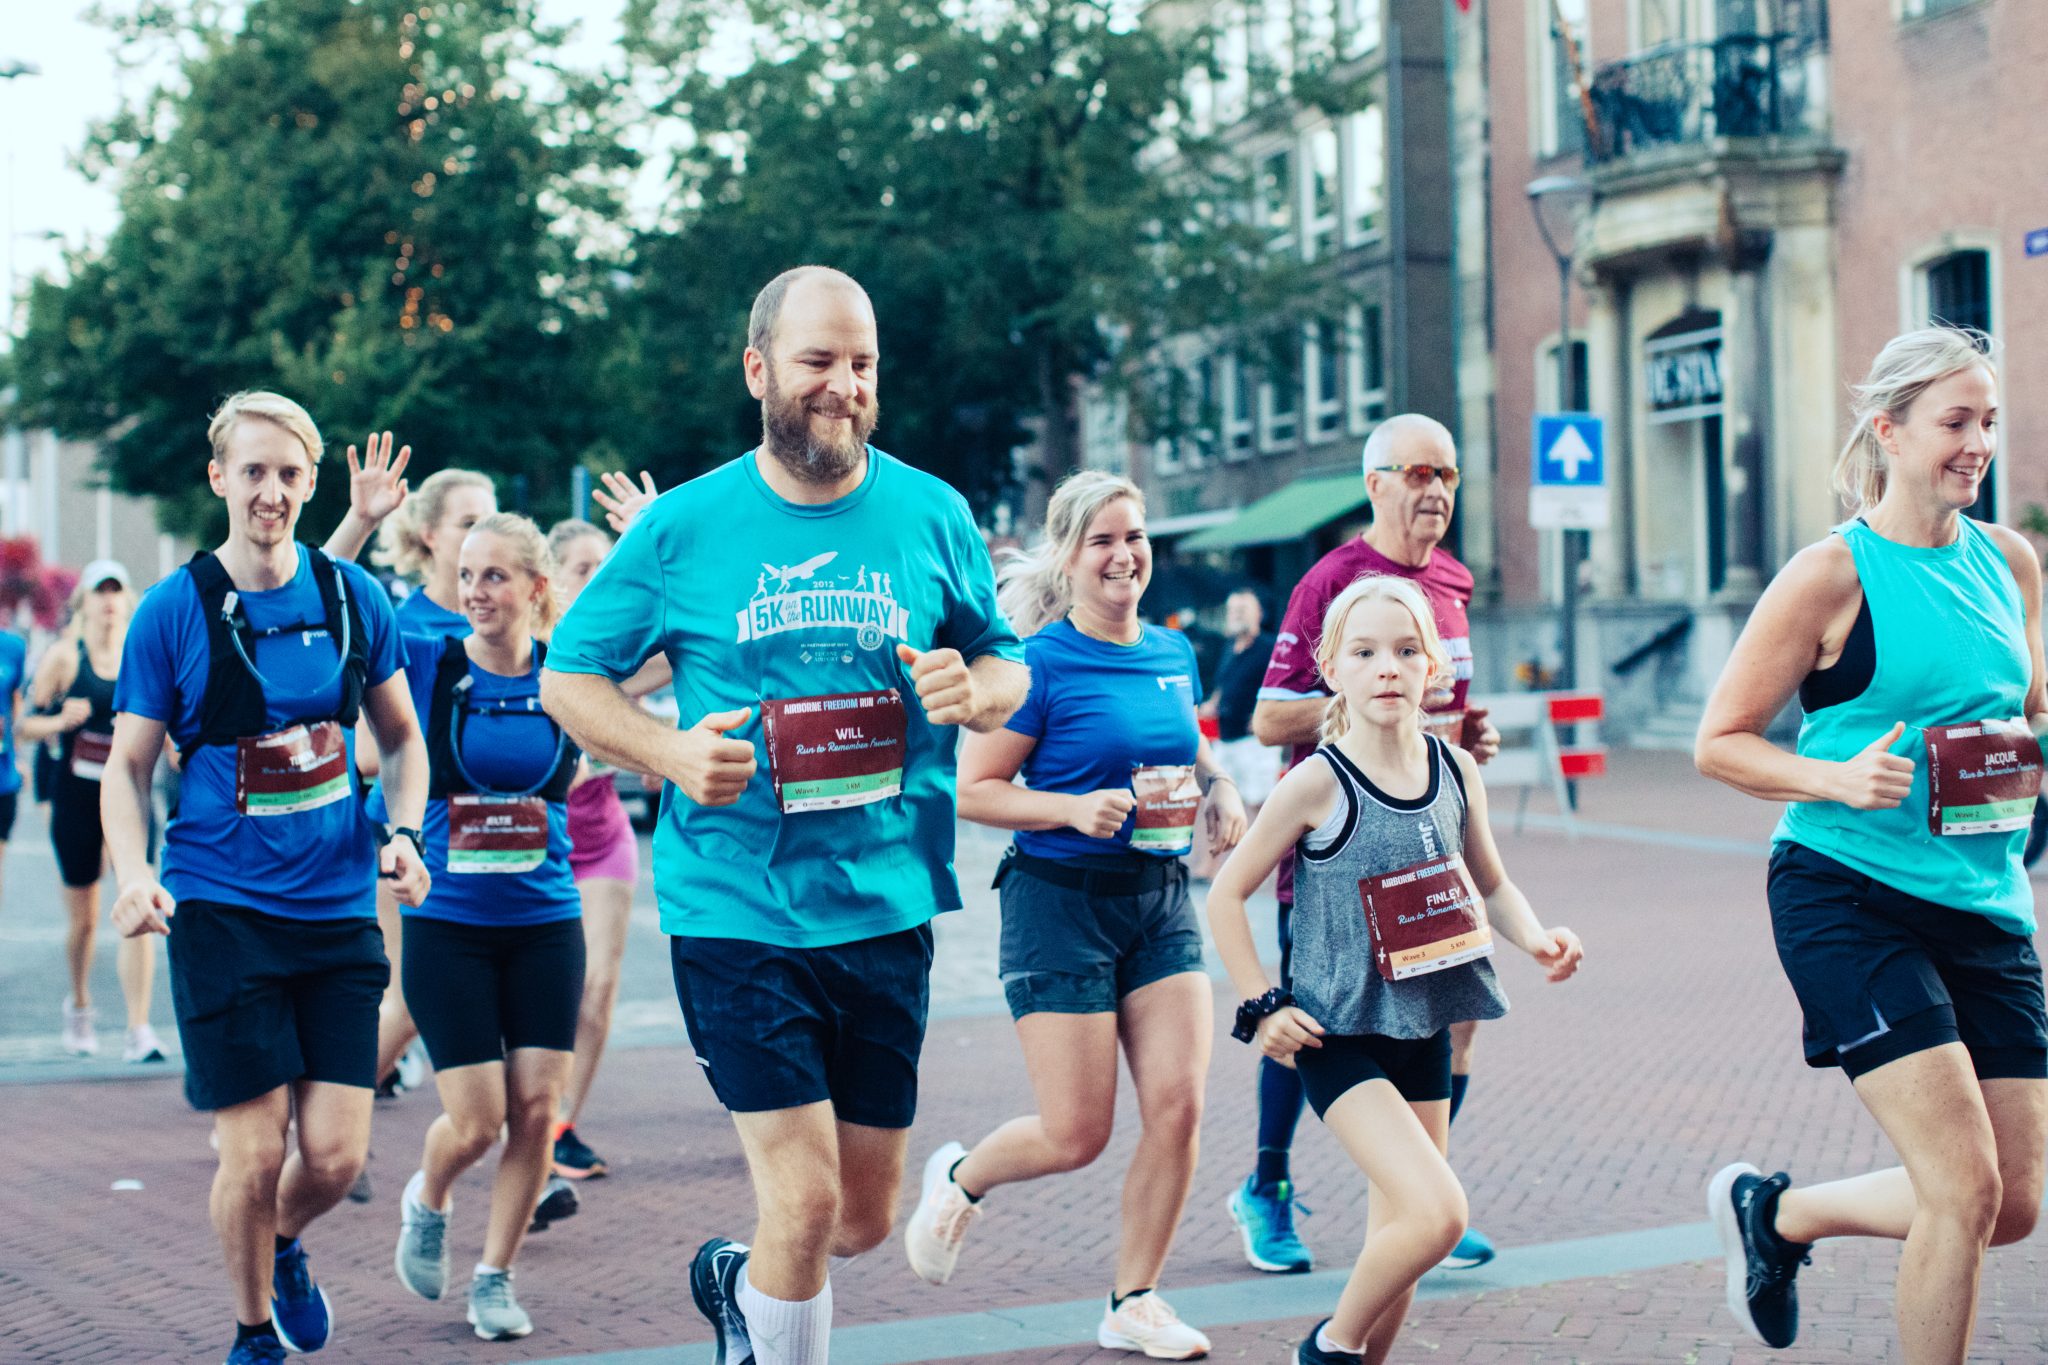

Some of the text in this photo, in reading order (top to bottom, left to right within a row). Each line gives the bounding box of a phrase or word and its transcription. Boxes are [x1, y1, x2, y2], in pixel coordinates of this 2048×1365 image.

[812, 580, 835, 588] 2012
[755, 595, 892, 632] 5K on the RUNWAY
[784, 697, 874, 715] AIRBORNE FREEDOM RUN
[835, 727, 864, 740] WILL
[796, 737, 897, 755] Run to Remember Freedom
[1984, 750, 2018, 766] JACQUIE
[795, 787, 814, 795] Wave
[1382, 872, 1417, 889] AIRBORNE
[1416, 864, 1446, 880] FREEDOM
[1426, 886, 1461, 907] FINLEY
[1398, 912, 1416, 925] Run
[1416, 912, 1424, 921] to
[1456, 940, 1466, 948] KM
[1402, 953, 1420, 962] Wave
